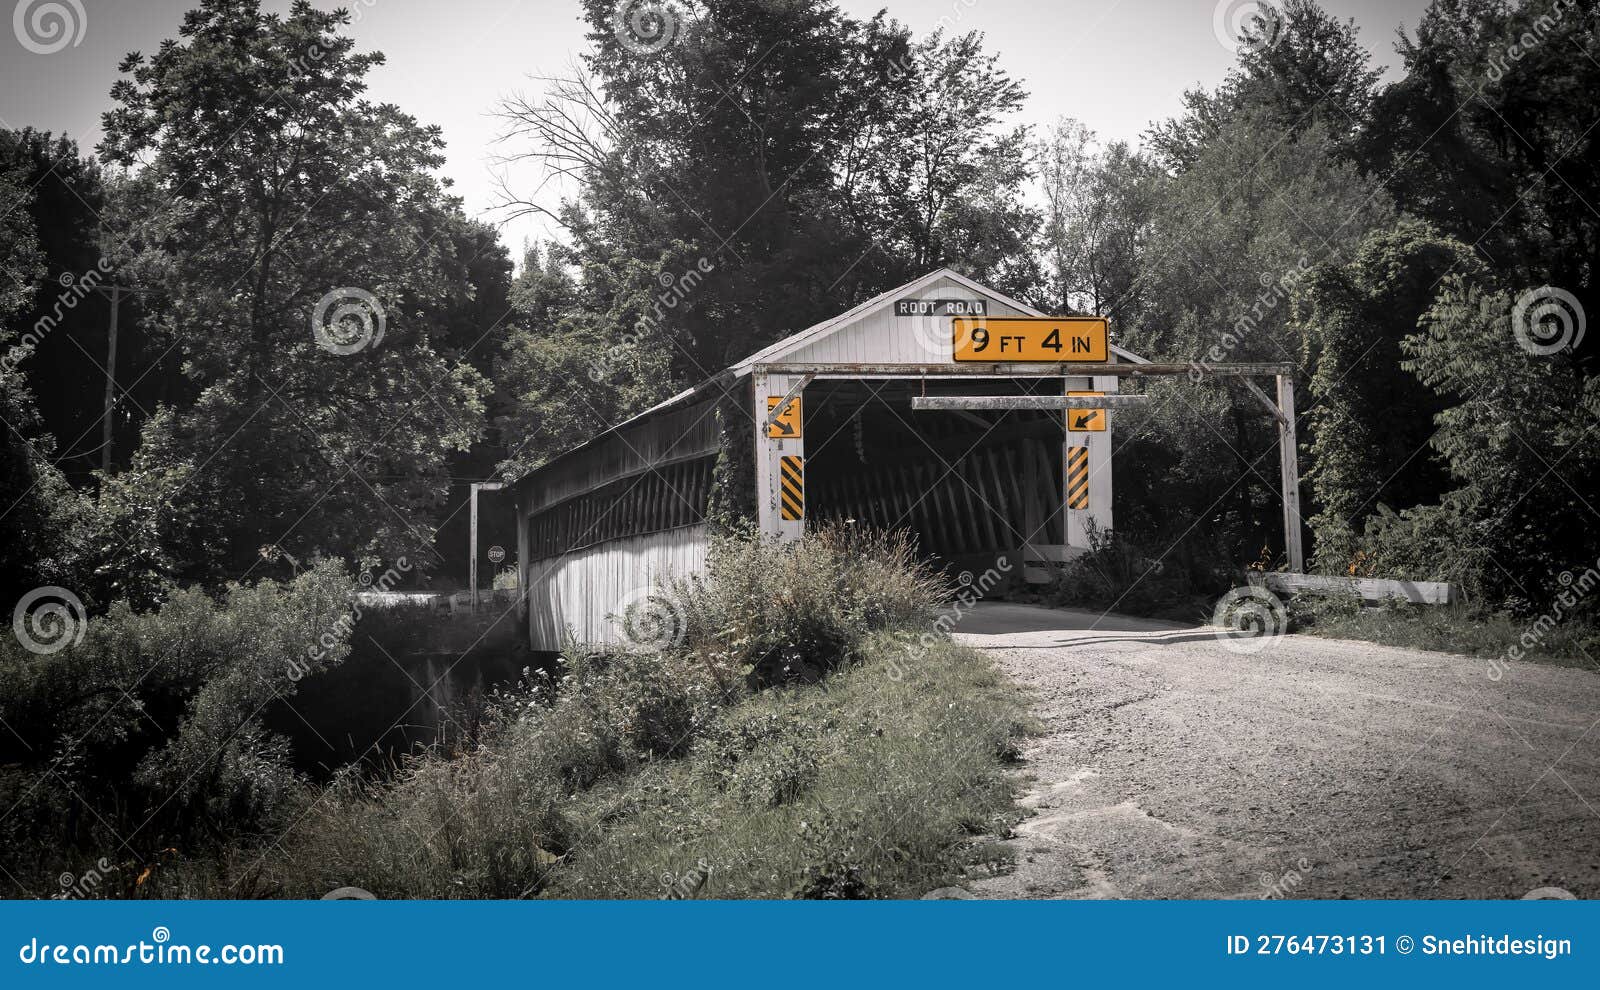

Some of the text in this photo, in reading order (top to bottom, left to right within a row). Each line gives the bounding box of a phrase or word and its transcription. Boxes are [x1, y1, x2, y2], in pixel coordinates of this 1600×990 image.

[900, 302, 983, 314] ROOT ROAD
[971, 328, 1090, 352] 9 FT 4 IN
